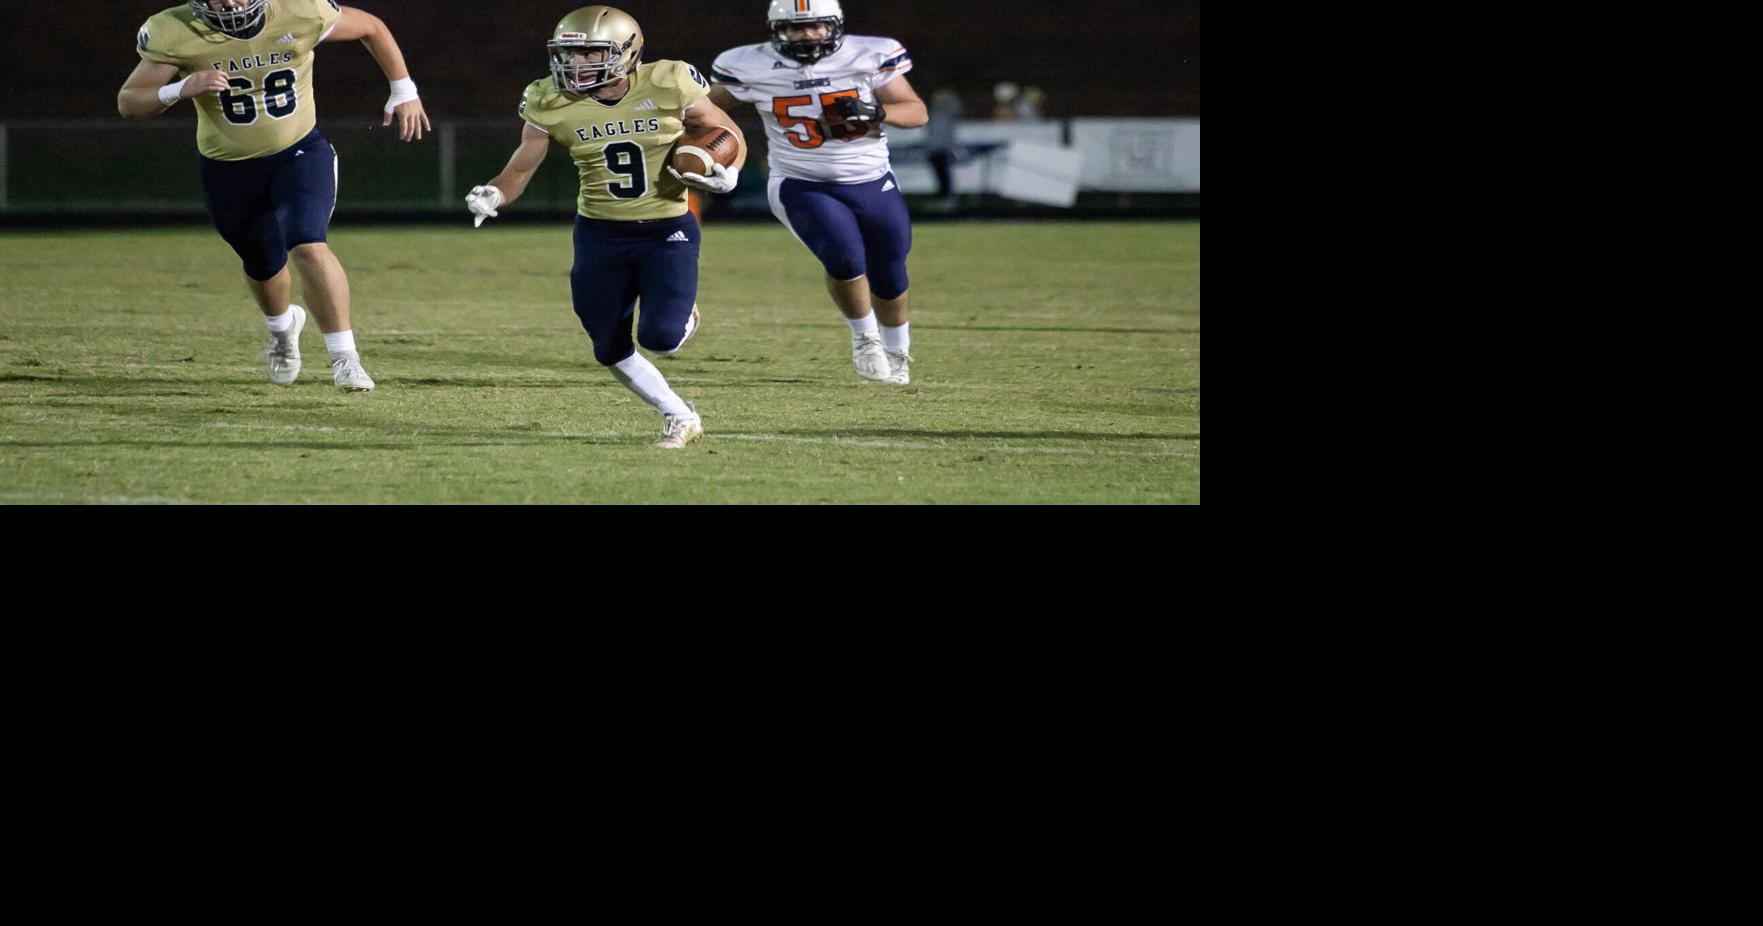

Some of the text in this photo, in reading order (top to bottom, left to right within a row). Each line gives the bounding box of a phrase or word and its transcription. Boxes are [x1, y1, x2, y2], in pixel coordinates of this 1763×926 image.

[218, 67, 298, 125] 68
[576, 117, 659, 142] EAGLES
[603, 140, 648, 199] 9
